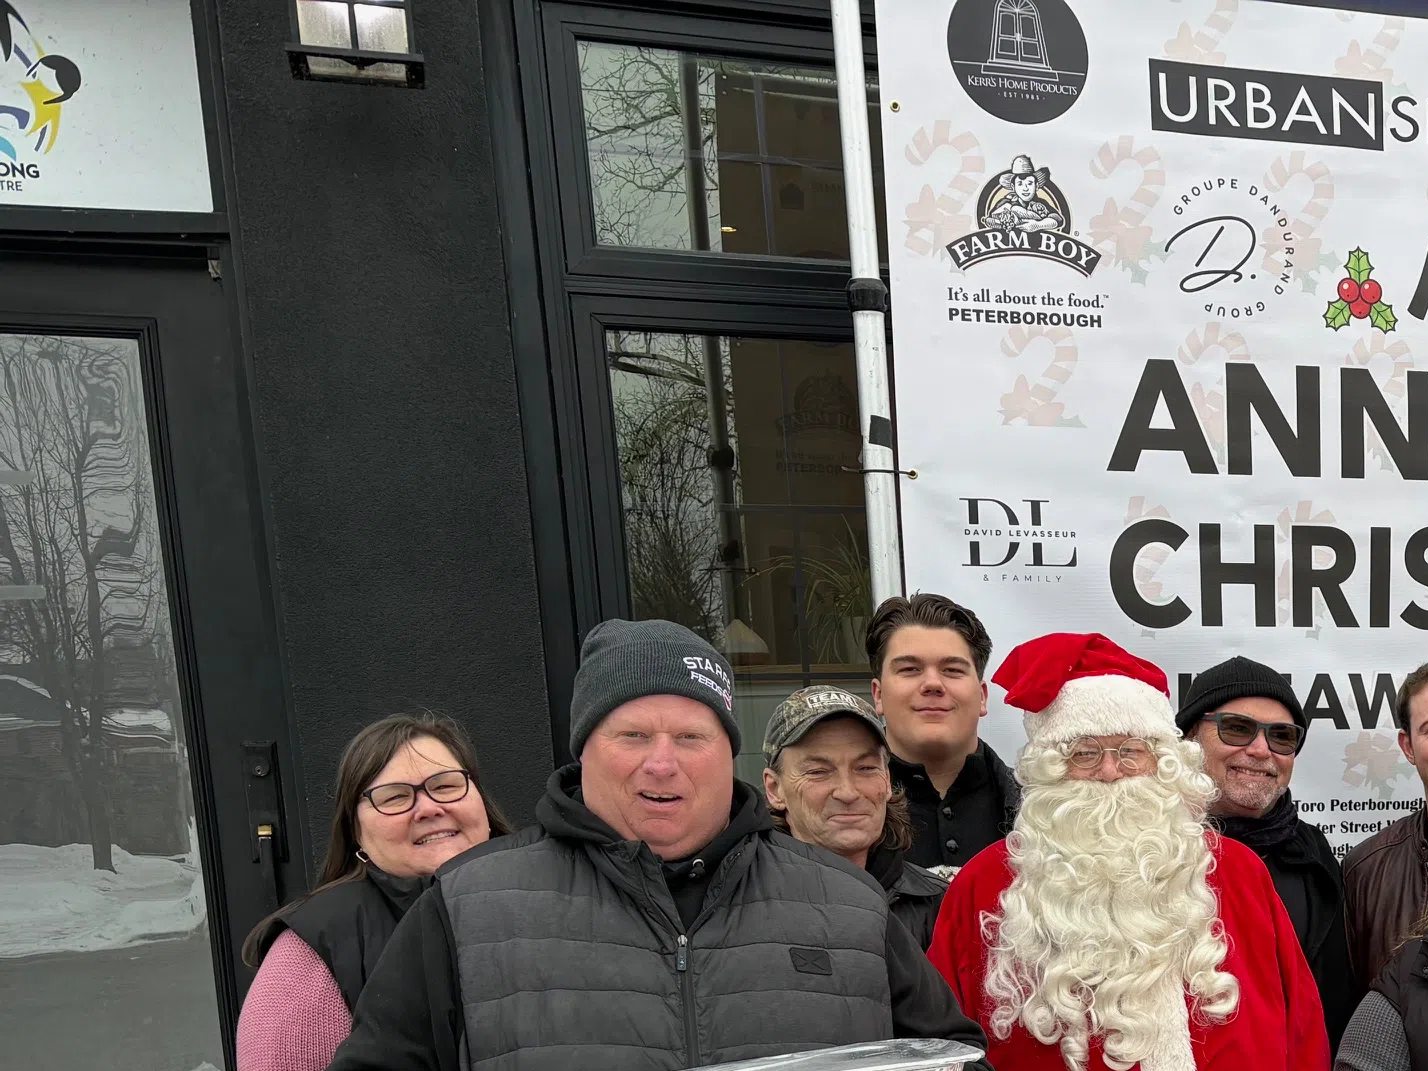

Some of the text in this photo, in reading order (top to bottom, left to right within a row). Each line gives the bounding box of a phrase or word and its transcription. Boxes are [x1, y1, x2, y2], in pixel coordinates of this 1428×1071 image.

[967, 75, 1078, 95] KERR'S HOME PRODUCTS
[1173, 178, 1238, 215] GROUPE
[951, 229, 1097, 270] FARM BOY
[1248, 185, 1295, 295] DANDURAND
[947, 286, 969, 301] It's
[972, 288, 991, 303] all
[994, 289, 1037, 305] about
[1041, 292, 1064, 306] the
[948, 307, 1102, 328] PETERBOROUGH
[1204, 301, 1265, 318] GROUP
[964, 528, 1076, 538] DAVID LEVASSEUR
[1001, 574, 1062, 582] FAMILY
[1340, 820, 1382, 834] Street
